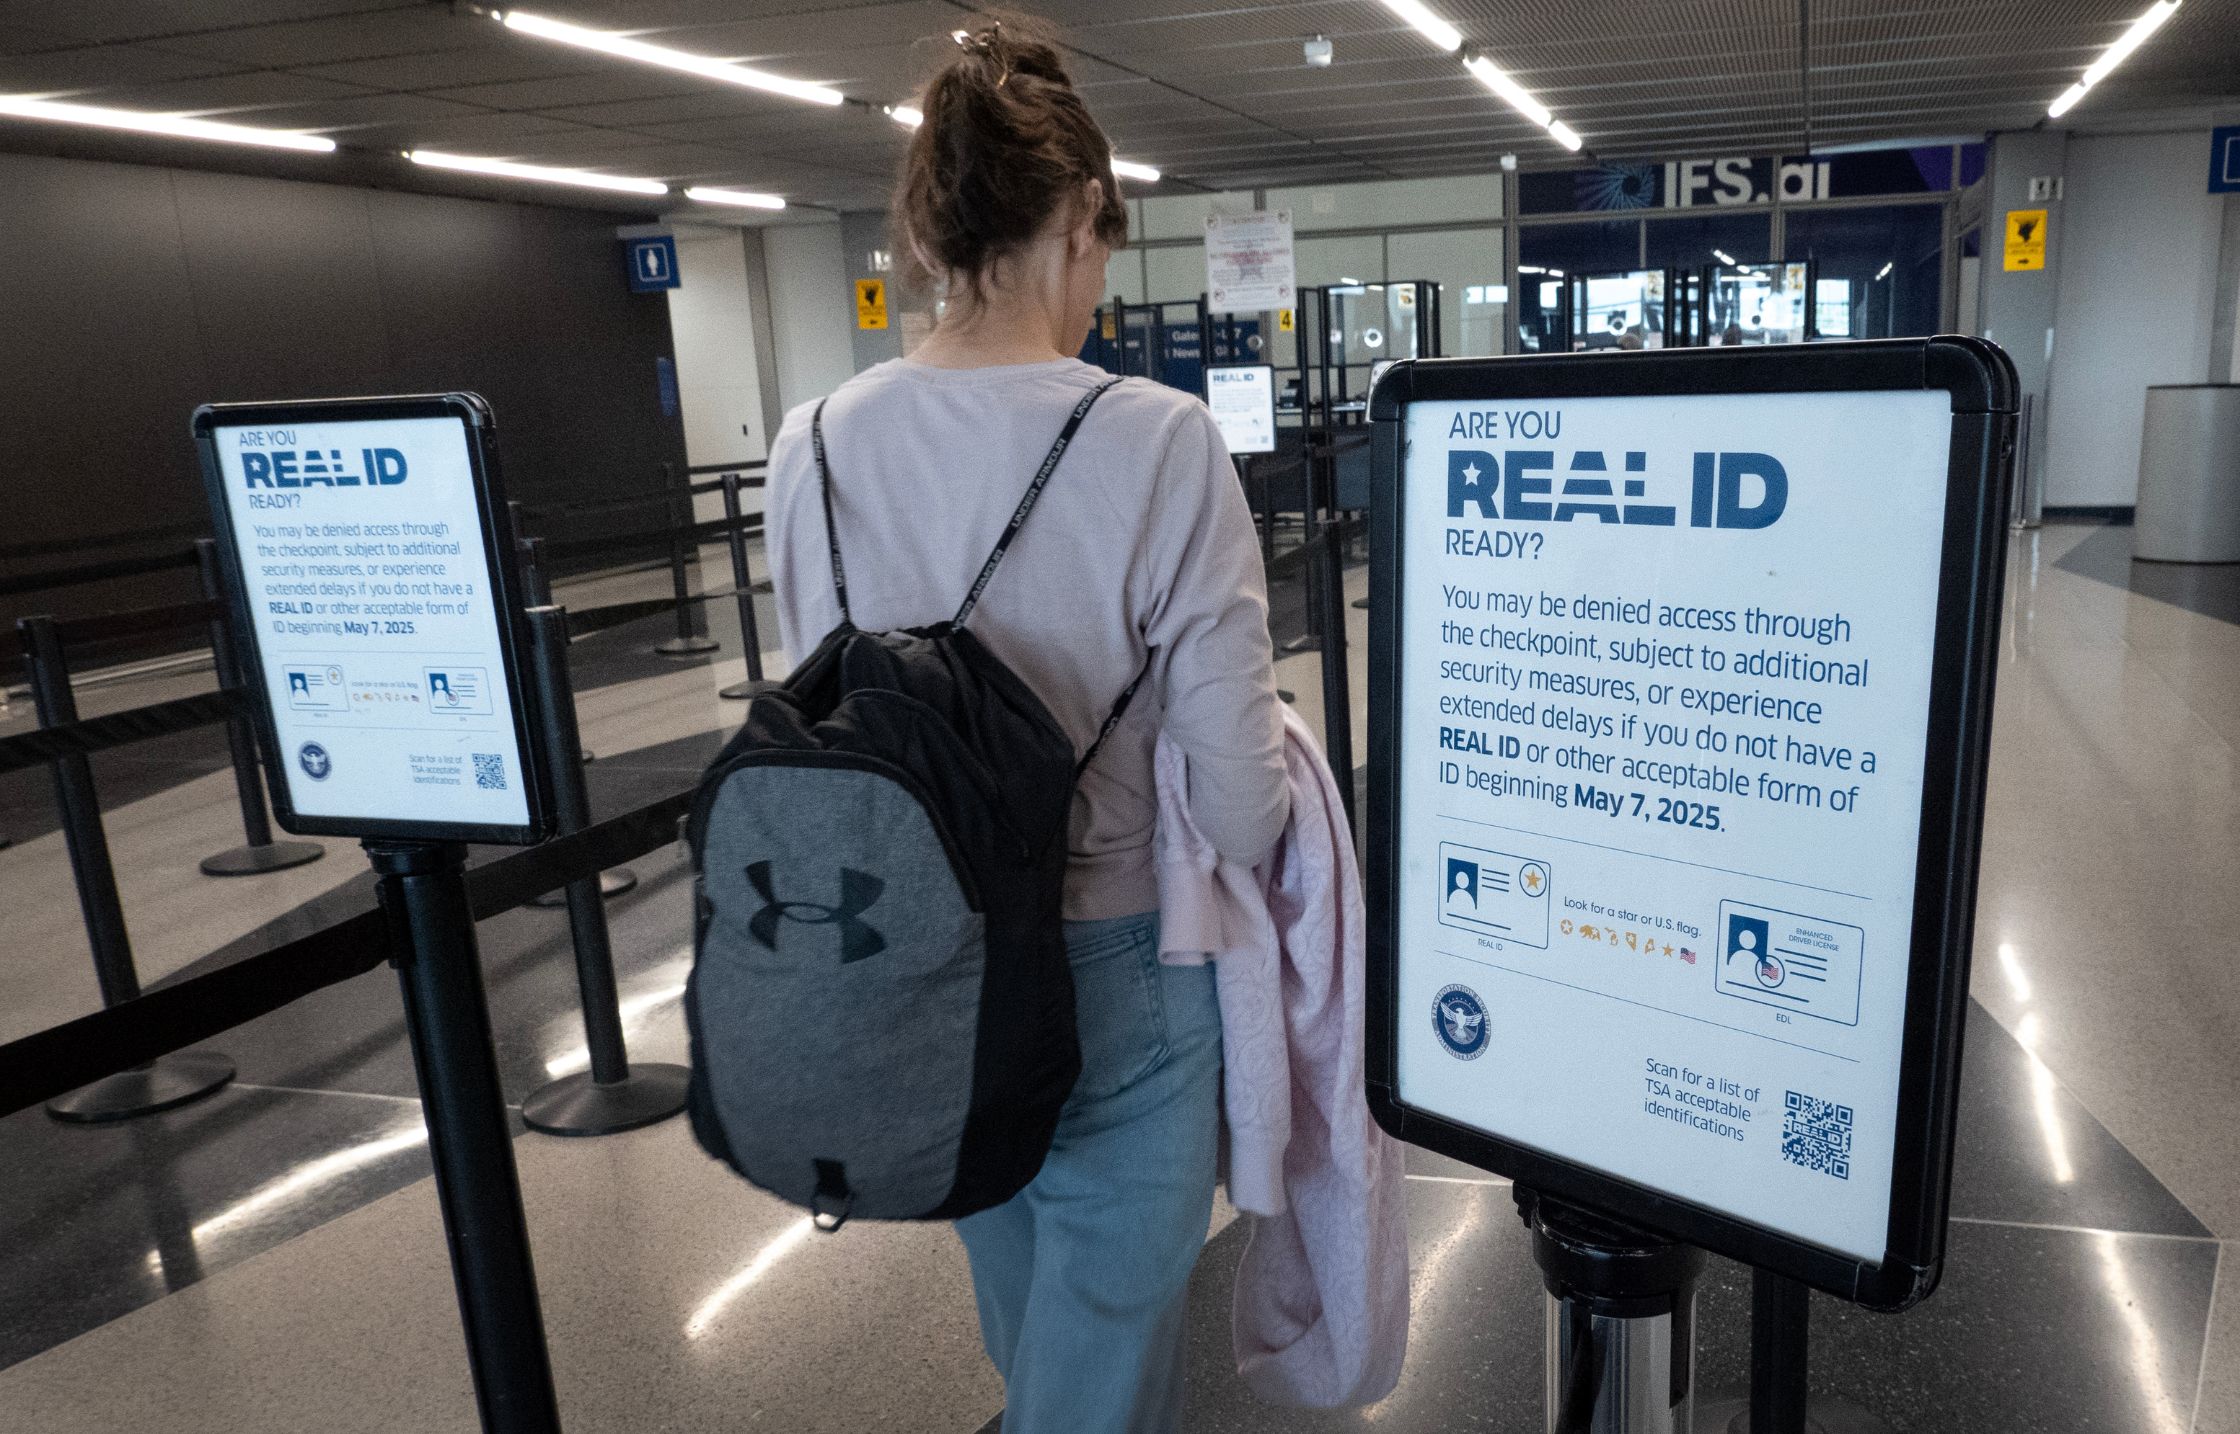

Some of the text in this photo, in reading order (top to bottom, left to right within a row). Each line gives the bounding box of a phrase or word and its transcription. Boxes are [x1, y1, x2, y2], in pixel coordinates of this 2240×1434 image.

[1282, 310, 1291, 328] 4
[1213, 373, 1242, 382] REAL
[240, 431, 296, 446] ARE YOU
[1449, 411, 1560, 439] ARE YOU
[241, 448, 408, 489] REAL ID
[1011, 438, 1067, 528] UNDER ARMOUR
[248, 493, 301, 509] READY?
[1447, 450, 1789, 530] REAL ID
[252, 522, 449, 539] You may be denied access through
[1446, 528, 1544, 560] READY?
[257, 541, 461, 558] the checkpoint, subject to additional
[261, 562, 446, 578] security measures, or experience
[972, 549, 1003, 600] ARMOUR
[265, 582, 473, 598] extended delays if you do not have a
[269, 601, 468, 616] REAL ID or other acceptable form of
[1442, 584, 1850, 645] You may be denied access through
[272, 620, 418, 636] ID beginning May 7, 2025.
[1441, 620, 1868, 687] the checkpoint, subject to additional
[1441, 660, 1822, 724] security measures, or experience
[1440, 695, 1876, 774] extended delays if you do not have a
[1440, 726, 1860, 813] REAL ID or other acceptable form of
[1440, 761, 1725, 832] ID beginning May 7, 2025.
[1564, 896, 1701, 939] Look for a star or U.S. flag.
[1478, 938, 1503, 951] REAL ID
[1788, 935, 1839, 952] DRIVER LICENSE
[1796, 928, 1833, 941] ENHANCED
[1776, 1013, 1792, 1025] EDL
[1646, 1058, 1760, 1102] Scan for a list of
[1645, 1078, 1751, 1122] TSA acceptable
[1645, 1098, 1744, 1141] identifications
